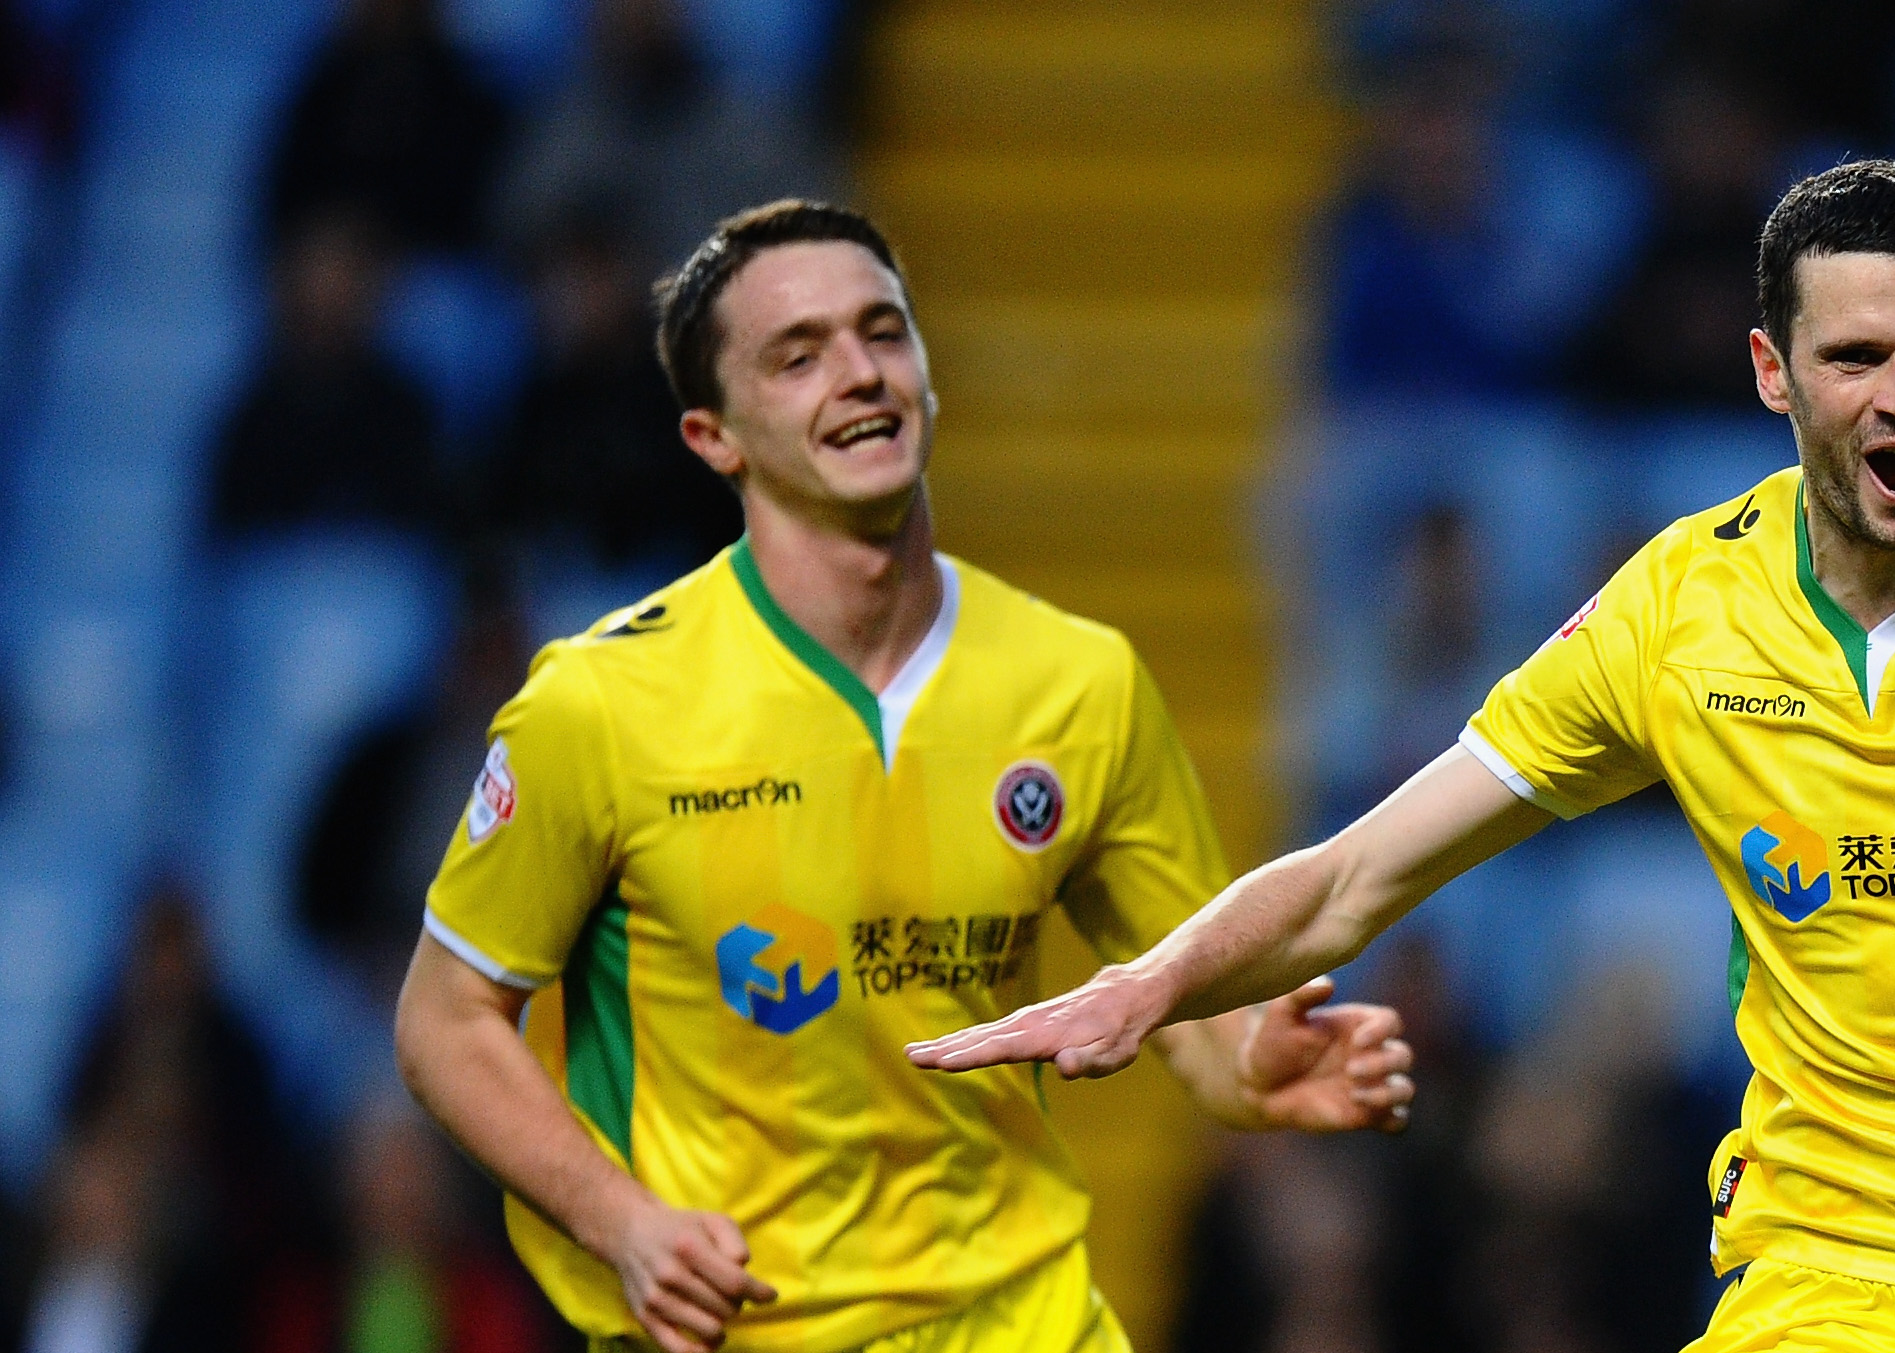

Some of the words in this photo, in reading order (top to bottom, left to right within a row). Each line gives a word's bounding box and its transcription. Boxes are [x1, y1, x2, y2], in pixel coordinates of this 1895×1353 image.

[1706, 692, 1806, 718] macron
[669, 778, 802, 815] macron
[1717, 1169, 1738, 1203] SUFC
